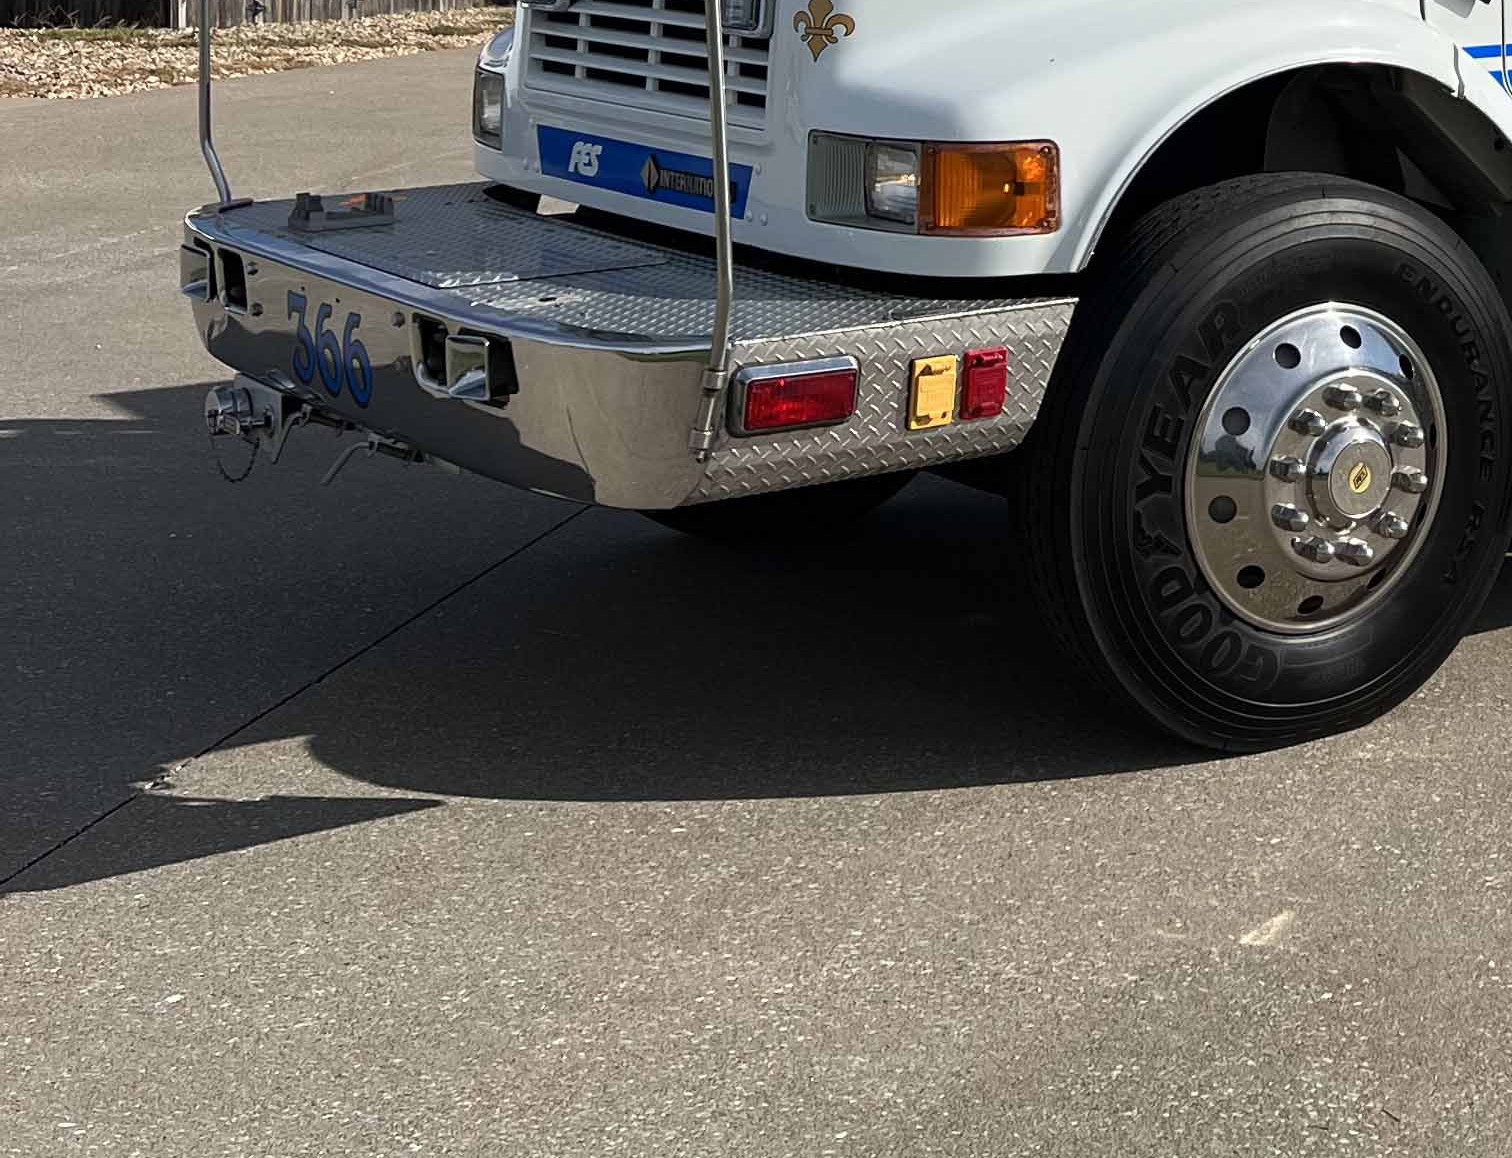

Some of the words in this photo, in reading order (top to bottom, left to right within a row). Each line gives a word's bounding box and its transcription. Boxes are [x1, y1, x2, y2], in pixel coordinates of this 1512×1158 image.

[287, 289, 373, 409] 366
[1396, 262, 1496, 483] ENDURANCE
[1133, 298, 1286, 692] GOODYEAR
